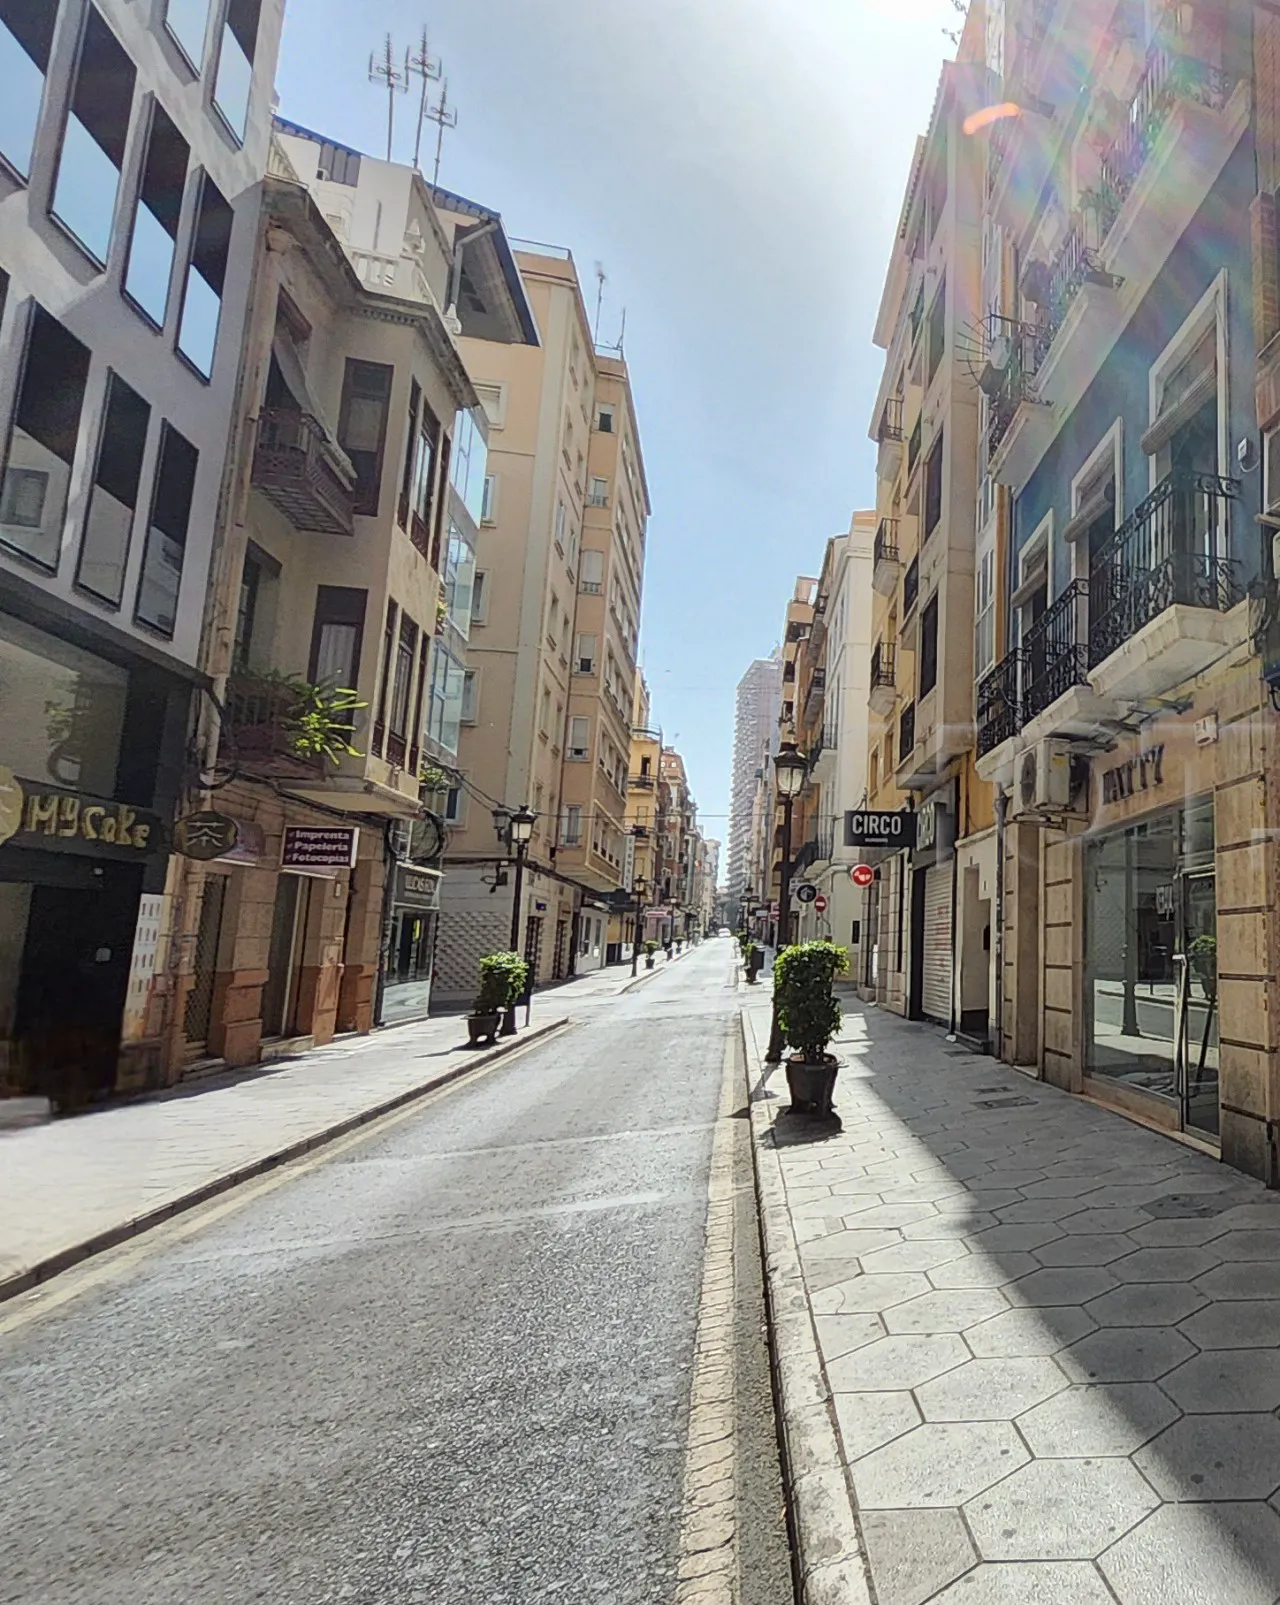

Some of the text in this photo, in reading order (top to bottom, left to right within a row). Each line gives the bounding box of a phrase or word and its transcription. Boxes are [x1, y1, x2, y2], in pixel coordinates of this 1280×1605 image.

[852, 814, 902, 835] CIRCO
[295, 830, 350, 841] Imprenta
[292, 853, 349, 864] Fotocopias
